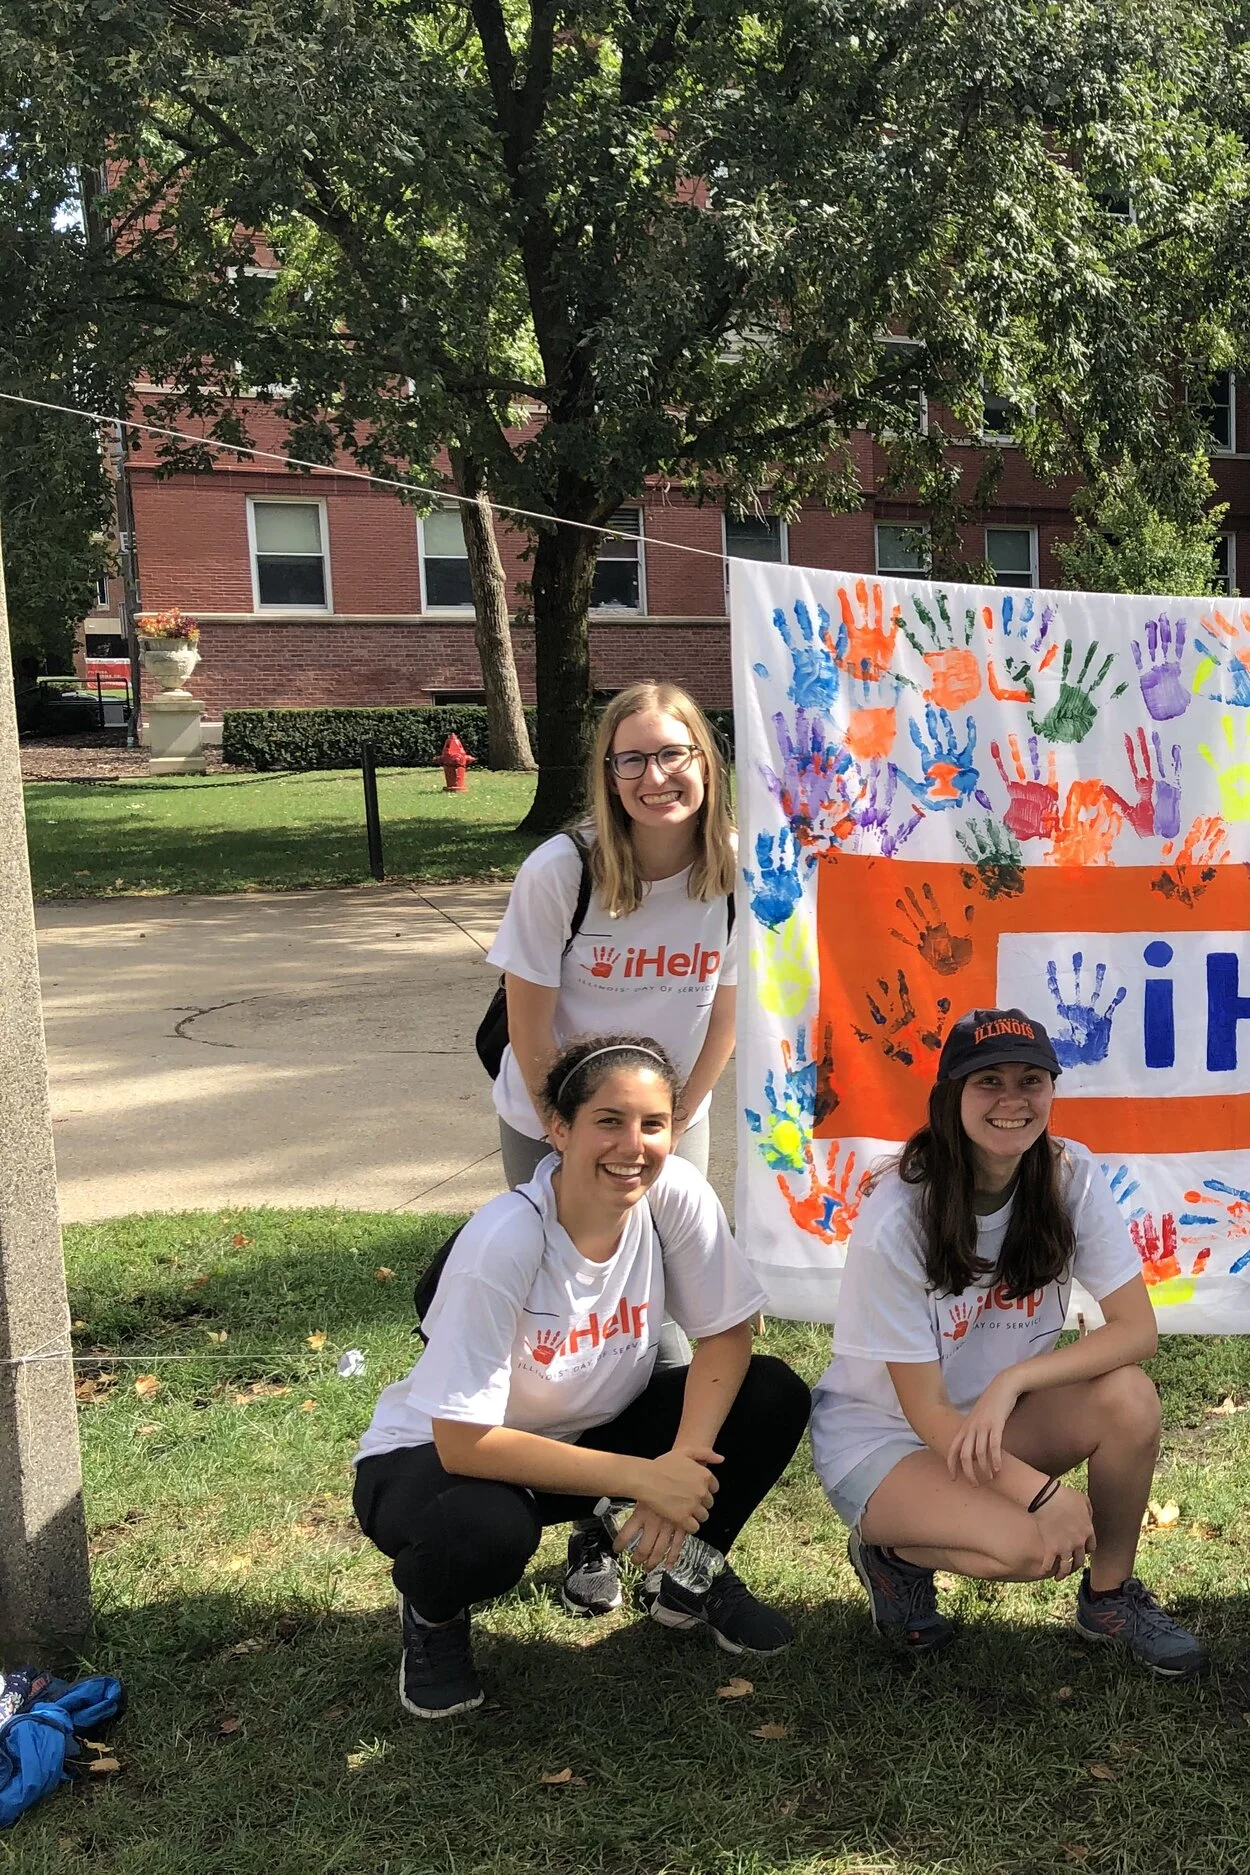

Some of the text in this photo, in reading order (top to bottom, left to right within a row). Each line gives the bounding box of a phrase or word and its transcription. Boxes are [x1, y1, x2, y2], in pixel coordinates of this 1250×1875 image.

[623, 942, 721, 983] iHelp
[659, 984, 673, 993] OF
[974, 1021, 1035, 1045] ILLINOIS
[989, 1321, 1001, 1329] OF
[573, 1360, 593, 1372] DAY
[613, 1341, 640, 1355] SERV
